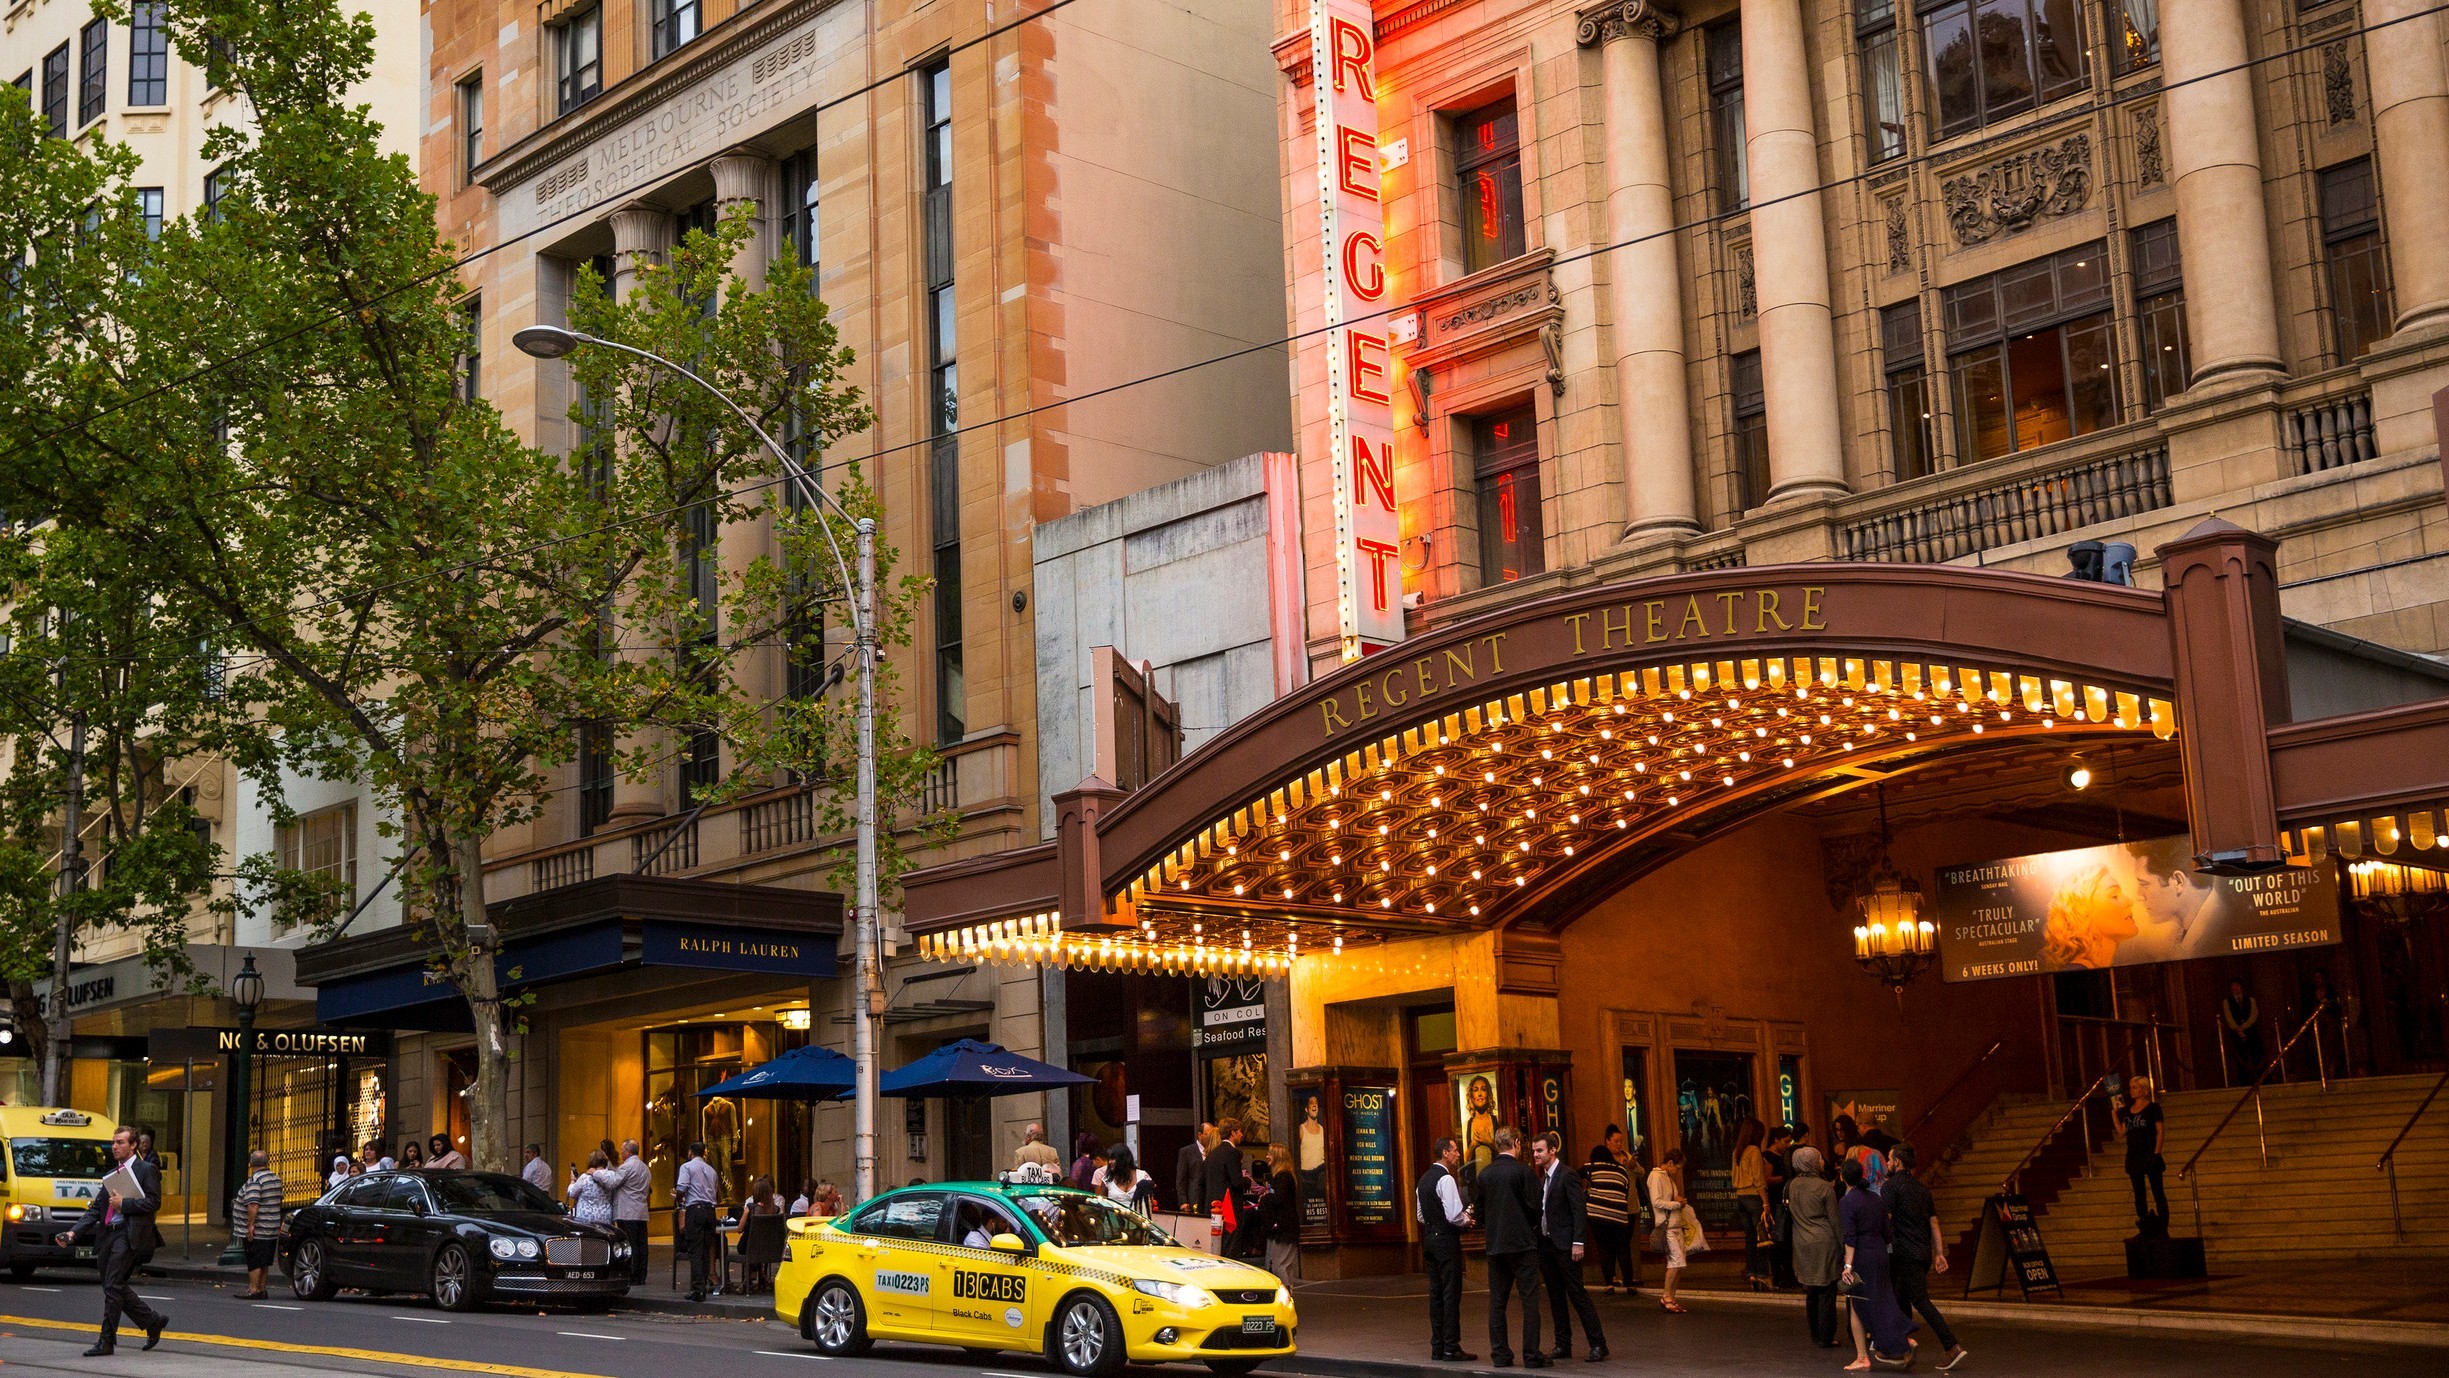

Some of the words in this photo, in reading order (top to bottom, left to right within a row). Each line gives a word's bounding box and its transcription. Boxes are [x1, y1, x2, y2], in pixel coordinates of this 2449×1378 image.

[599, 73, 739, 171] MELBOURNE
[537, 130, 700, 223] THEOSOPHICAL
[716, 61, 818, 136] SOCIETY
[1330, 16, 1400, 612] REGENT
[1319, 632, 1507, 738] REGENT
[1564, 587, 1827, 655] THEATRE
[2266, 874, 2283, 889] OF
[2288, 870, 2320, 887] THIS
[2270, 907, 2299, 915] AUSTRALIAN
[679, 937, 731, 954] RALPH
[740, 941, 800, 958] LAUREN
[2232, 935, 2279, 950] LIMITED
[2284, 930, 2328, 945] SEASON
[1962, 967, 1969, 977] 6
[1972, 963, 2004, 977] WEEKS
[2008, 960, 2039, 973] ONLY!
[1214, 1013, 1228, 1021] ON
[256, 1033, 269, 1050] &
[275, 1033, 366, 1053] OLUFSEN
[1204, 1028, 1244, 1043] Seafood
[1344, 1093, 1383, 1110] GHOST
[1858, 1104, 1896, 1113] Marriner
[1027, 1167, 1042, 1177] TAXI
[2026, 1268, 2050, 1280] OPEN
[952, 1308, 972, 1319] Black
[973, 1310, 993, 1321] Cabs
[1246, 1321, 1263, 1331] 0223
[1265, 1321, 1275, 1331] PS
